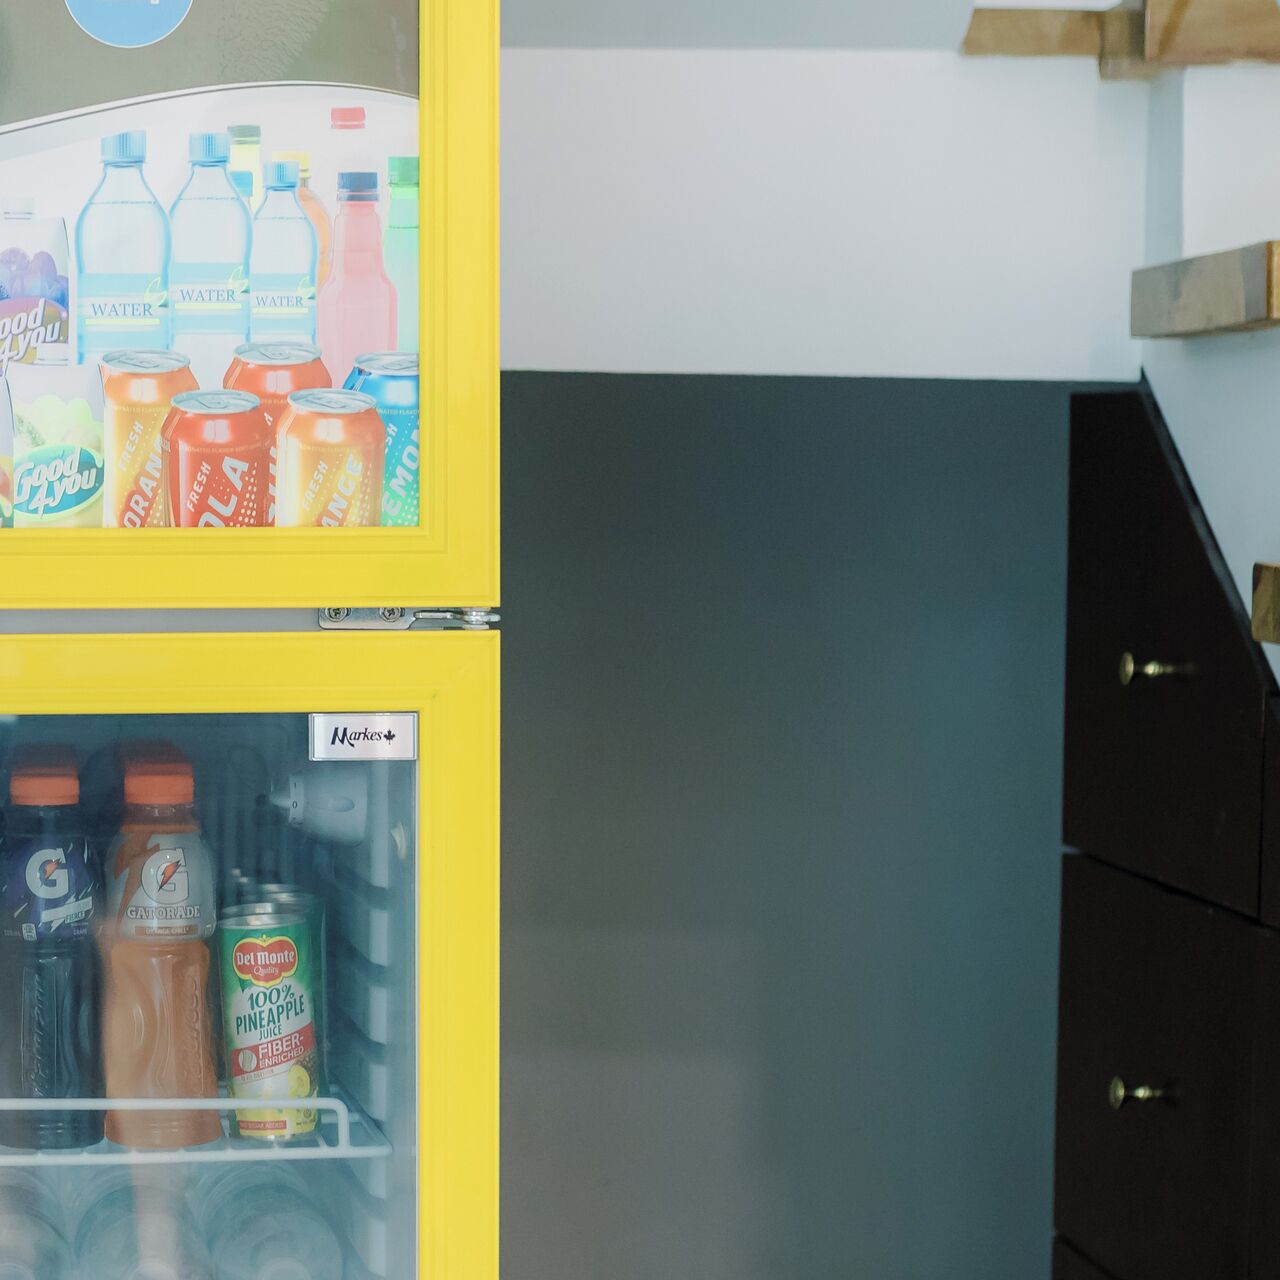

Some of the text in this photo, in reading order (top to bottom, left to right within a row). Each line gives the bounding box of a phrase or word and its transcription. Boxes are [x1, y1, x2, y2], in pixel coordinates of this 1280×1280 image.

[179, 288, 237, 303] WATER
[255, 295, 304, 308] WATER
[91, 302, 153, 318] WATER
[13, 445, 82, 505] Good
[123, 434, 162, 528] ORAN
[186, 461, 211, 513] FRESH
[302, 460, 329, 510] FRESH
[198, 455, 250, 528] OLA
[322, 453, 364, 528] ANGE
[330, 726, 383, 748] Markes
[25, 847, 69, 899] G
[141, 847, 190, 905] G
[126, 905, 200, 919] GATORADE
[236, 950, 295, 966] Del Monte
[253, 965, 280, 976] Quality
[248, 984, 295, 1011] 100%
[235, 994, 305, 1036] PINEAPPLE
[258, 1032, 304, 1059] FIBER-
[259, 1024, 283, 1041] JUICE
[259, 1046, 305, 1070] ENRICHED
